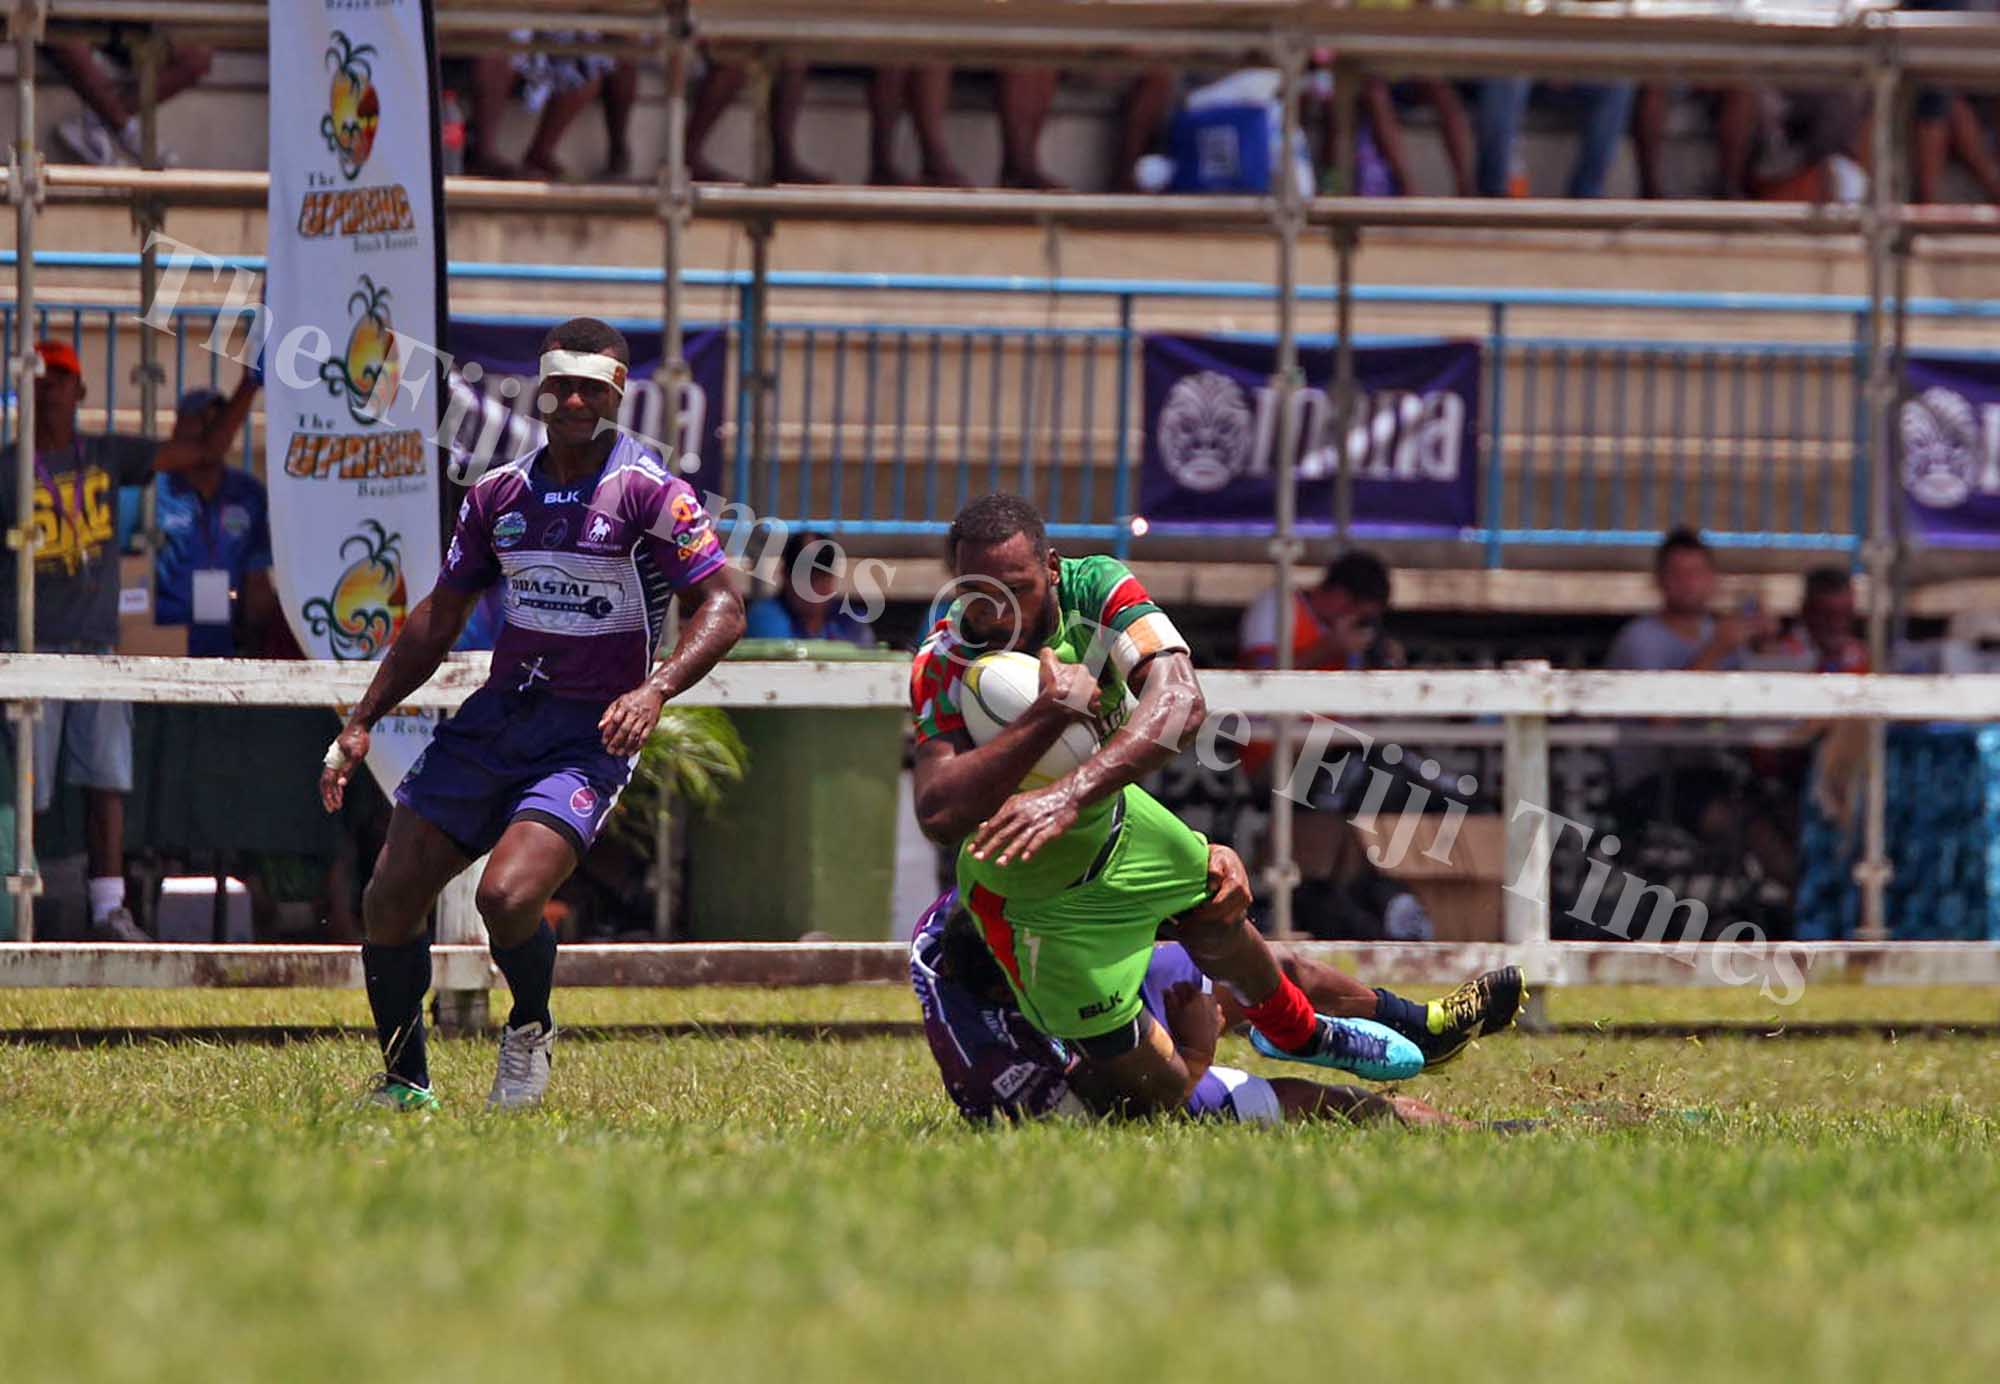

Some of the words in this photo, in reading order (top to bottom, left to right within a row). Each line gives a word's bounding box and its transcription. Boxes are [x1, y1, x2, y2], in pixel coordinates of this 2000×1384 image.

[297, 413, 334, 429] The
[543, 490, 584, 504] BLK
[1078, 990, 1123, 1020] BLK
